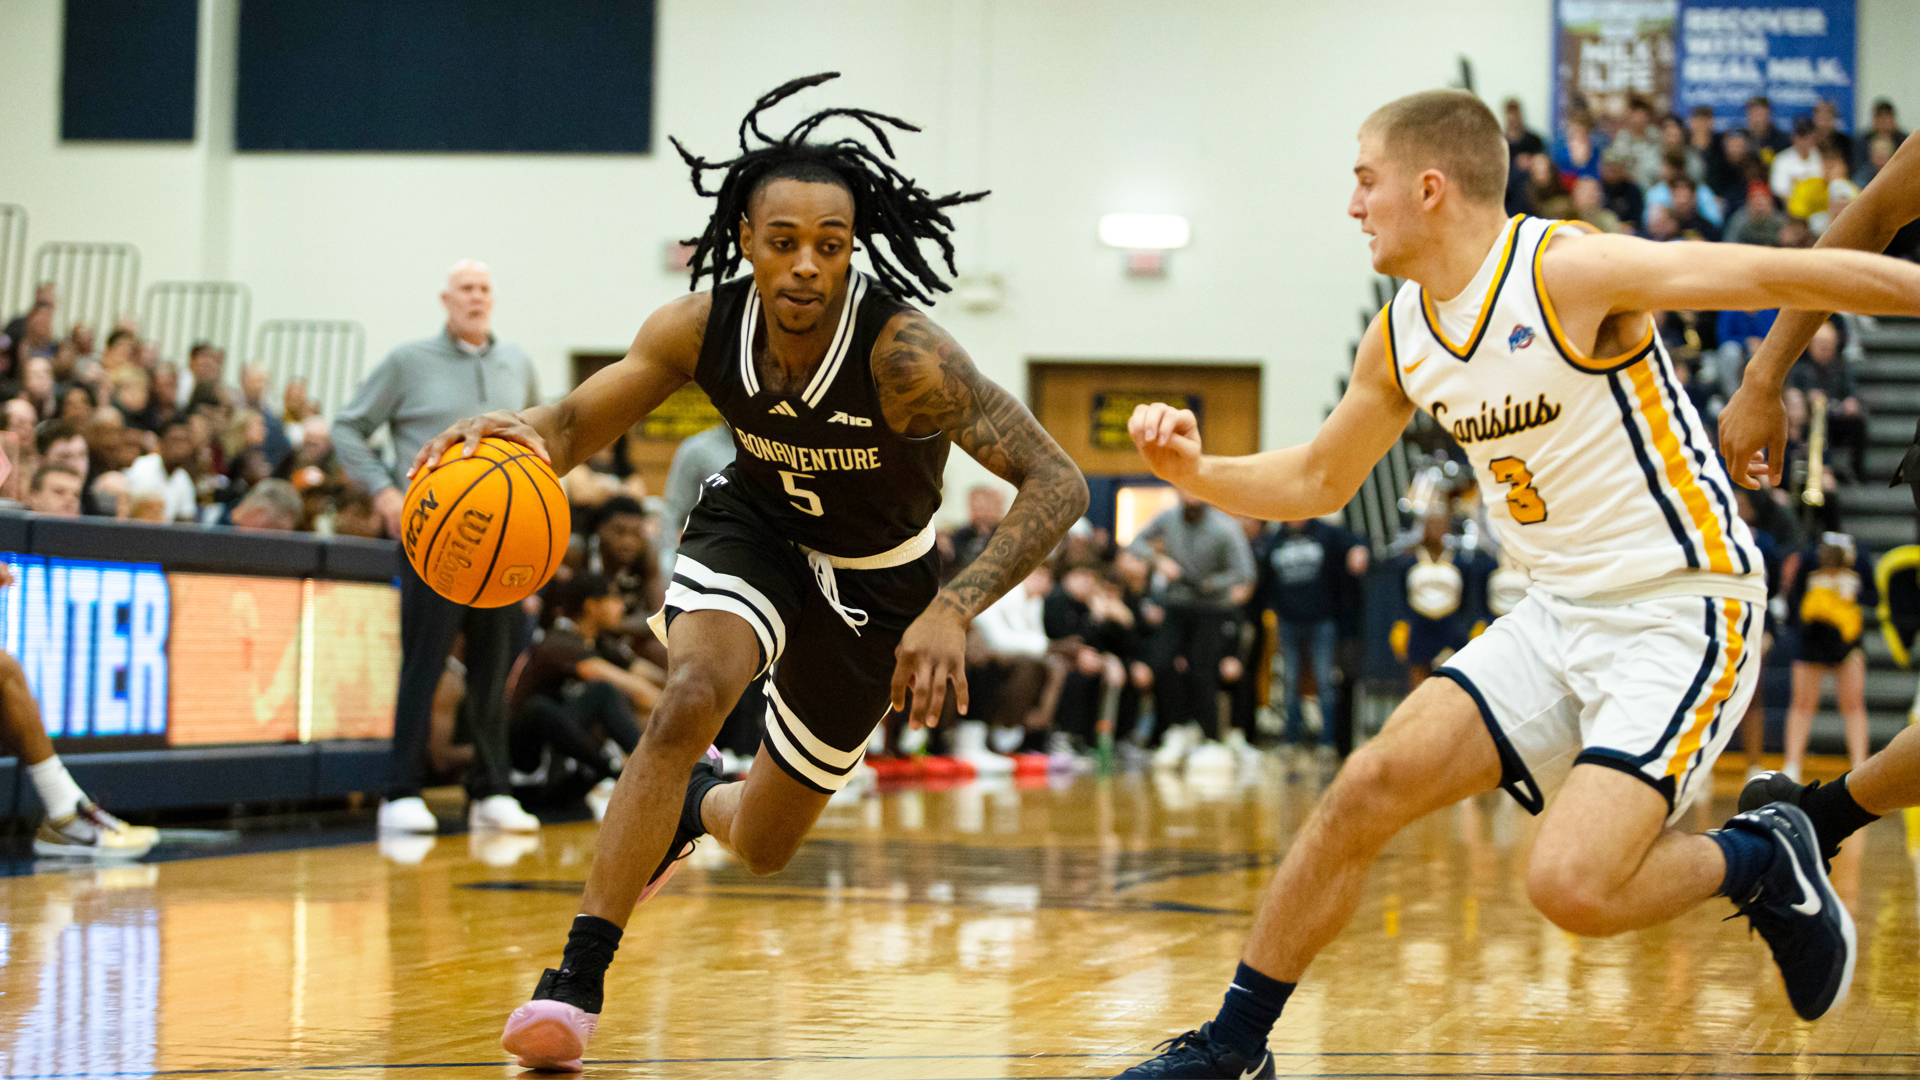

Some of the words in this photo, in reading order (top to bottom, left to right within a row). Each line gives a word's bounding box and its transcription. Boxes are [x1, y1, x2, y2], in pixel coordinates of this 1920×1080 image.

[1431, 393, 1562, 443] Canisius
[735, 427, 882, 472] BONAVENTURE
[777, 470, 825, 517] 5
[1488, 455, 1548, 525] 3
[436, 506, 495, 595] Wilson
